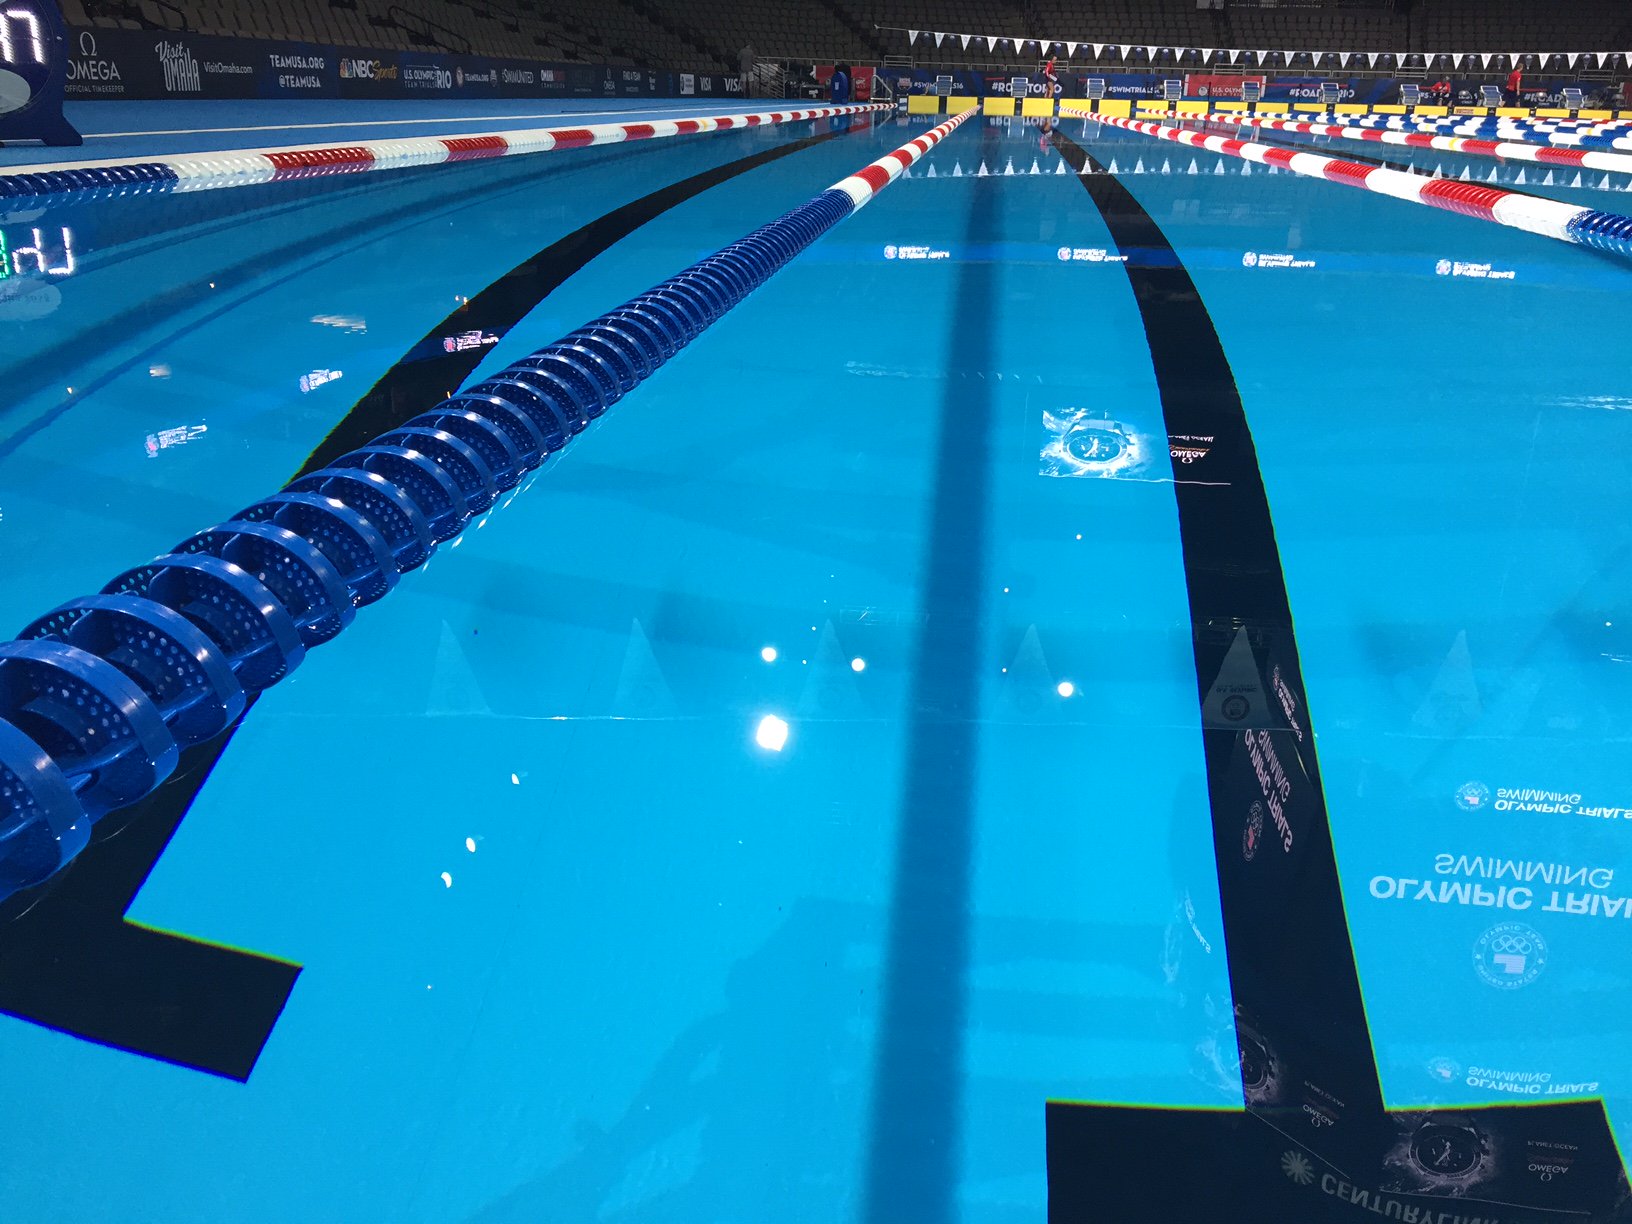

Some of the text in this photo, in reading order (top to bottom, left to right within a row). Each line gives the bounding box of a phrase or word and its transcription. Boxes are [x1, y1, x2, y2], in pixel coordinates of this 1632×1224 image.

[155, 40, 184, 61] Visit
[163, 48, 201, 92] OMAHA
[203, 61, 253, 74] VisitOmaha.com
[269, 54, 325, 70] TEAMUSA.ORG
[352, 60, 375, 78] NBC
[65, 60, 121, 82] OMEGA
[437, 70, 452, 89] RIO
[64, 84, 125, 94] OFFICIAL TIMEKEEPER
[278, 75, 321, 88] @TEAMUSA
[700, 76, 712, 92] VISA
